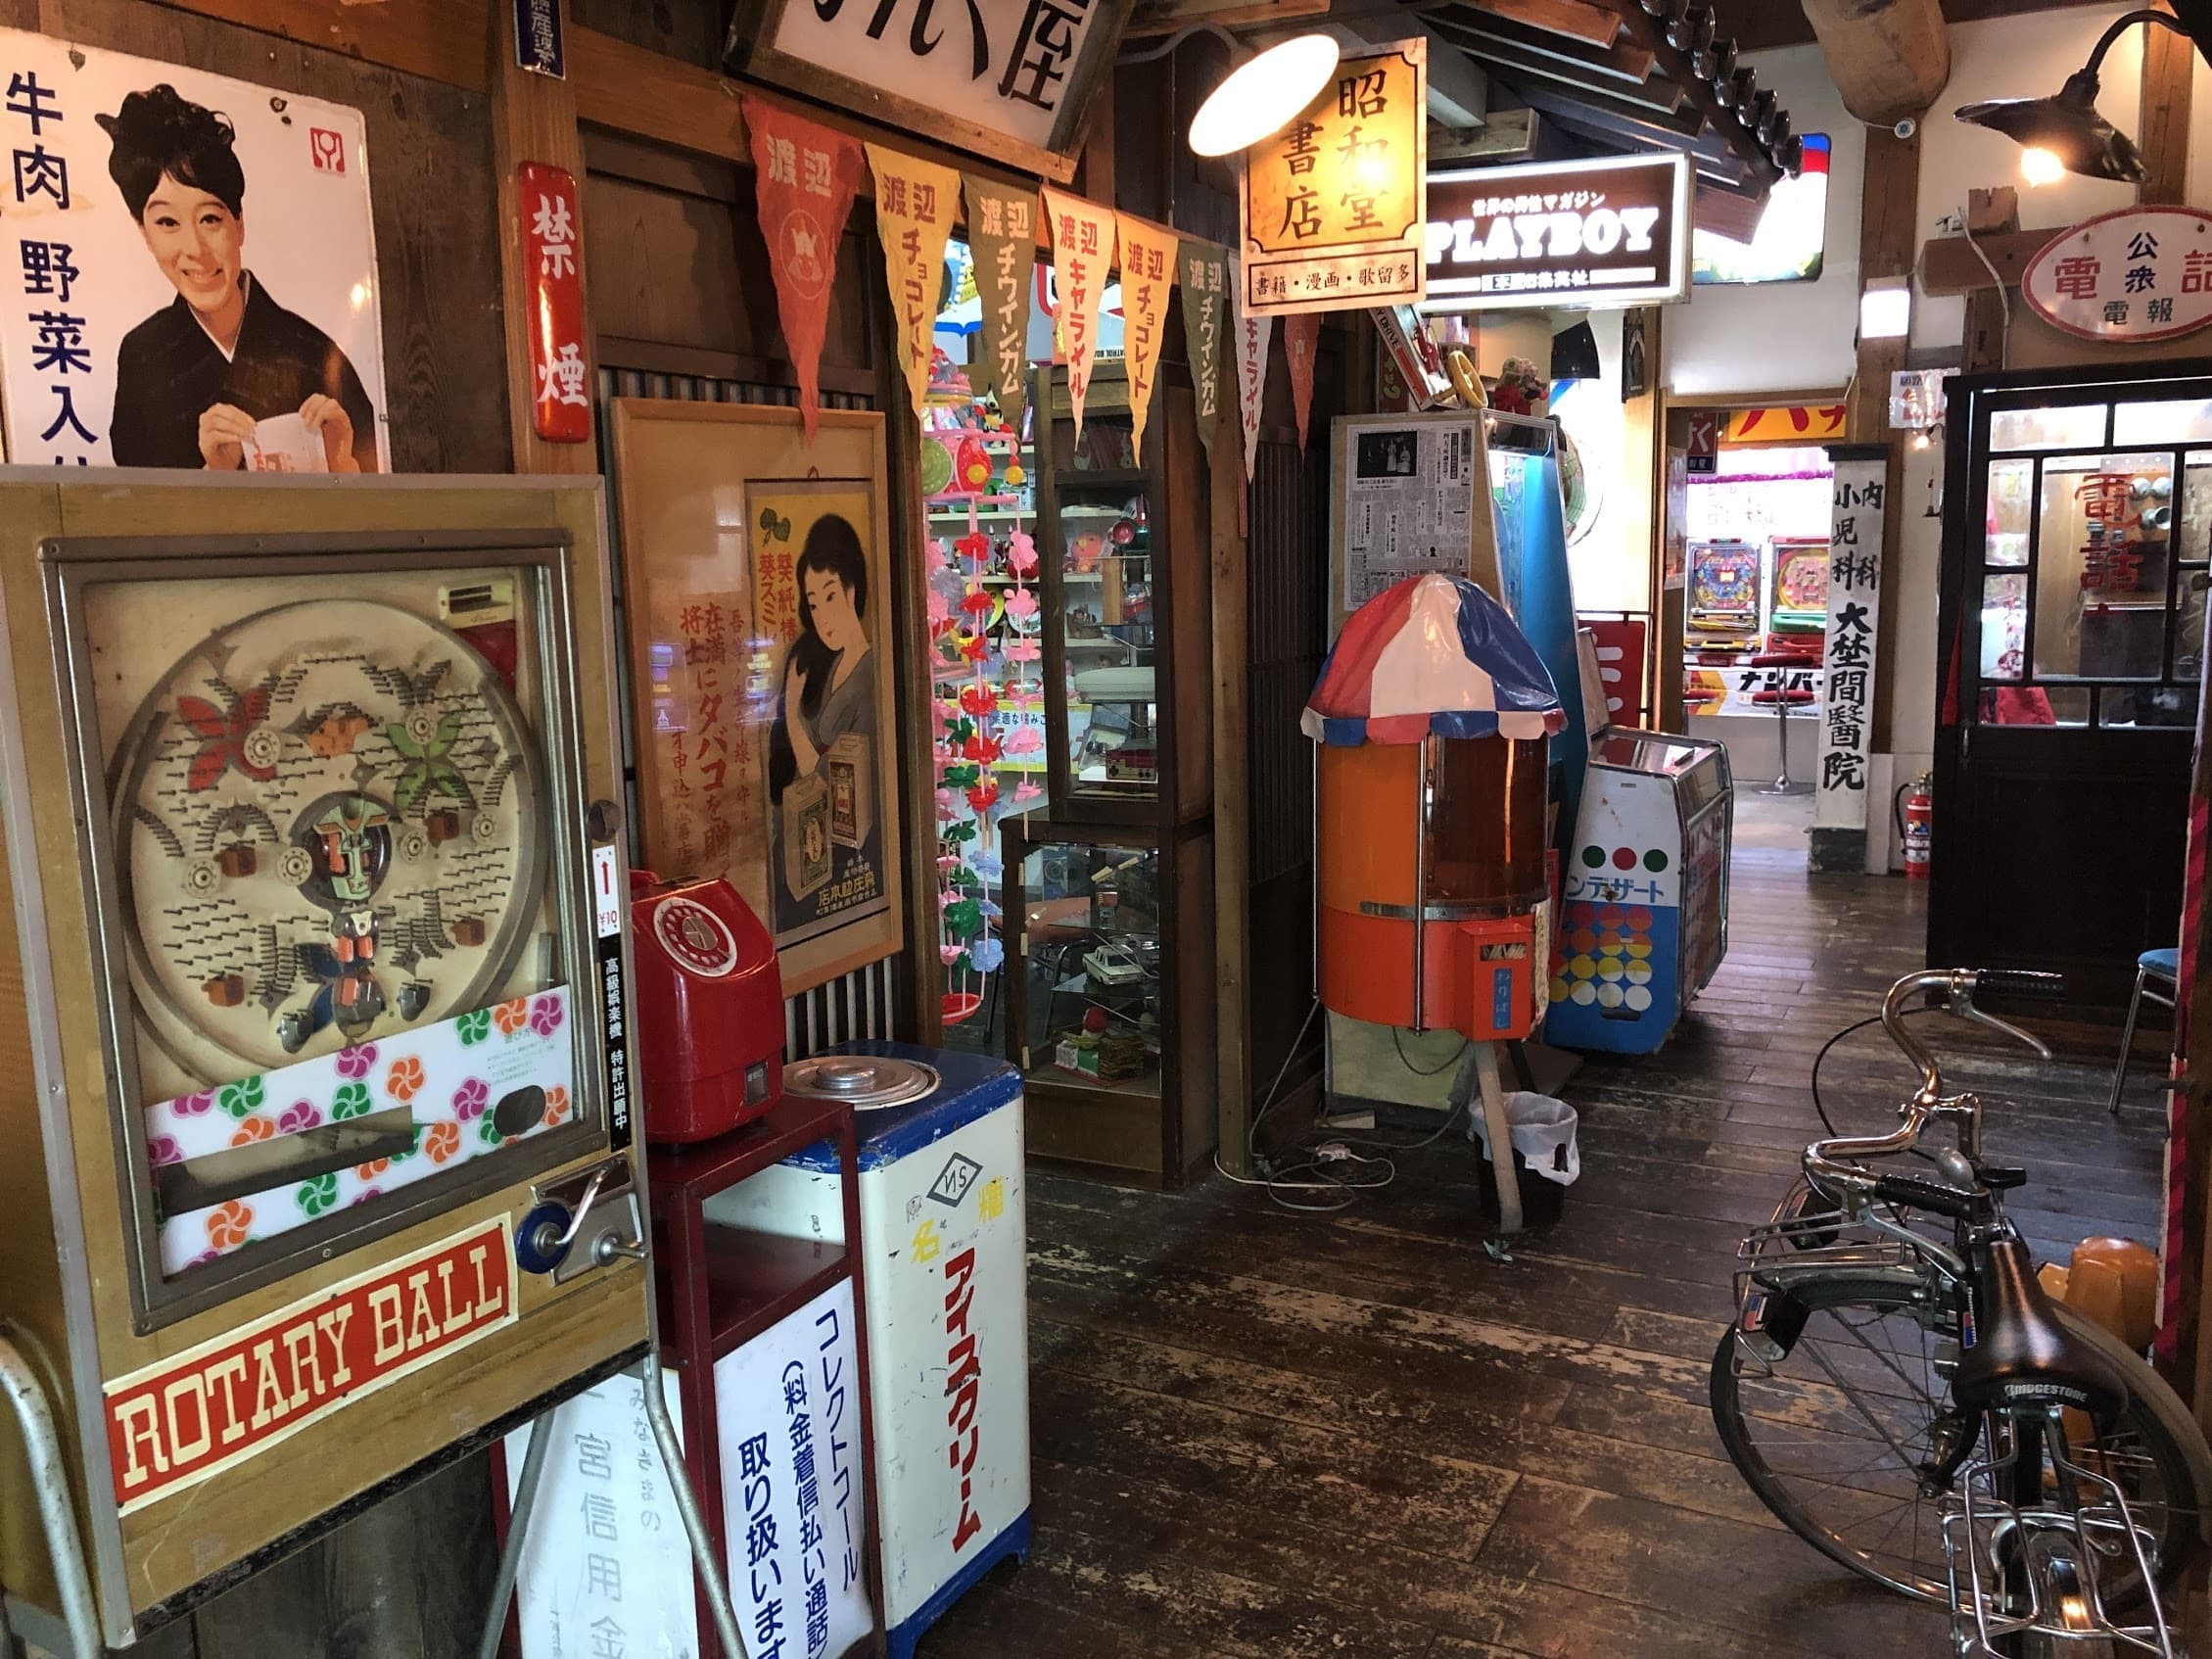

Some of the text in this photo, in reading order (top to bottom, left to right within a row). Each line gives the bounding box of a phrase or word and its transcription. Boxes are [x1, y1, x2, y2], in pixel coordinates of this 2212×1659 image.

[767, 133, 831, 197] 渡辺
[883, 173, 935, 223] 渡辺
[1279, 120, 1324, 240] 書店
[1338, 70, 1389, 232] 昭和堂
[6, 71, 99, 467] 牛肉 野菜入
[980, 197, 1028, 239] 渡辺
[1059, 213, 1098, 257] 渡辺
[1128, 241, 1164, 282] 渡辺
[1426, 208, 1660, 264] PLAYBOY
[2125, 232, 2158, 293] 公衆
[531, 193, 588, 408] 禁煙
[902, 227, 927, 368] チョコレート
[1069, 259, 1086, 399] キャラメル
[1190, 259, 1222, 292] 渡辺
[2103, 298, 2174, 325] 電報
[1134, 285, 1154, 398] チョコレート
[1246, 317, 1258, 432] キャラメル
[1831, 483, 1860, 592] 小児科
[1855, 481, 1884, 591] 内科
[597, 911, 618, 927] ¥10
[611, 1050, 628, 1130] 特許出願中
[115, 1246, 503, 1489] ROTARY BALL
[944, 1248, 982, 1553] アイスクリーム
[2004, 1384, 2088, 1401] BRIDGESTONE
[816, 1308, 859, 1592] コレクトコール
